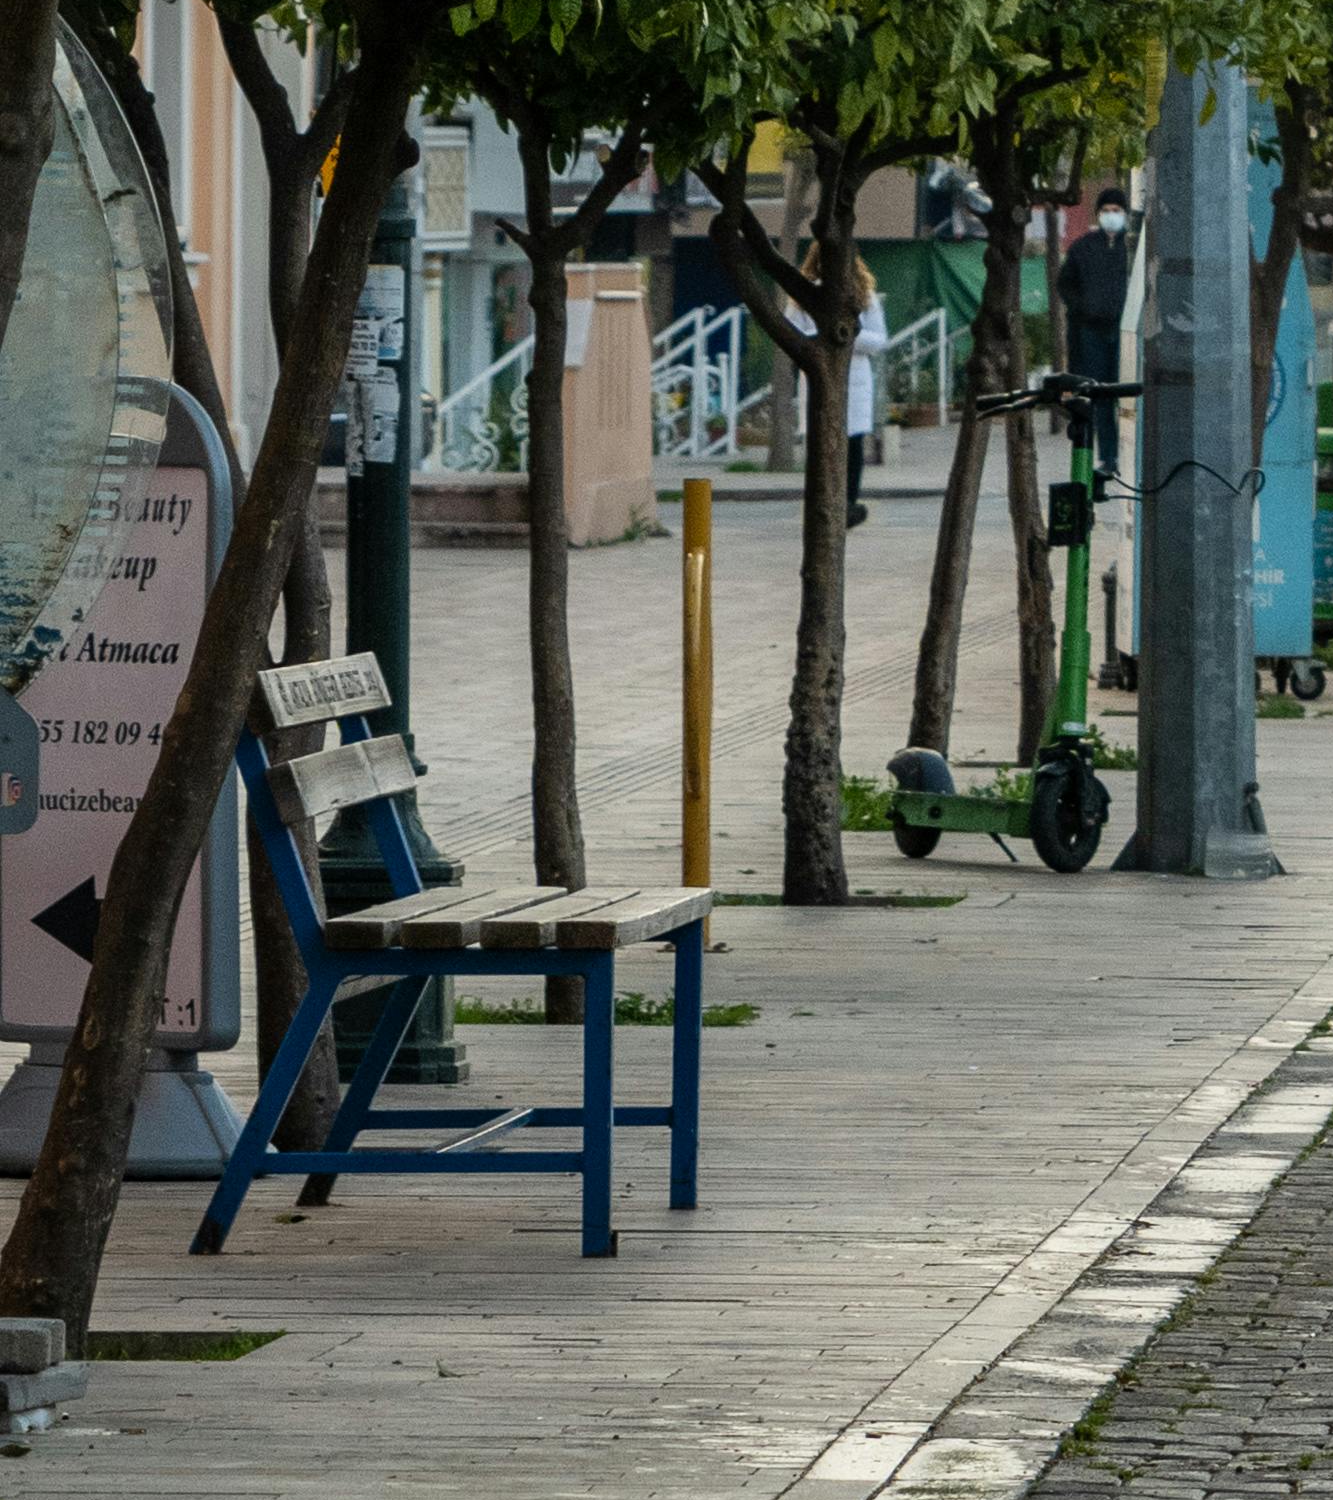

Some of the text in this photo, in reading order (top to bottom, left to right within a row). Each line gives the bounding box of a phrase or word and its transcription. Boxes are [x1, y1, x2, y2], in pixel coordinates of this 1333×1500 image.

[77, 631, 181, 664] Atmaca
[39, 720, 161, 745] 55 182 09 4
[39, 787, 142, 813] ucizebea
